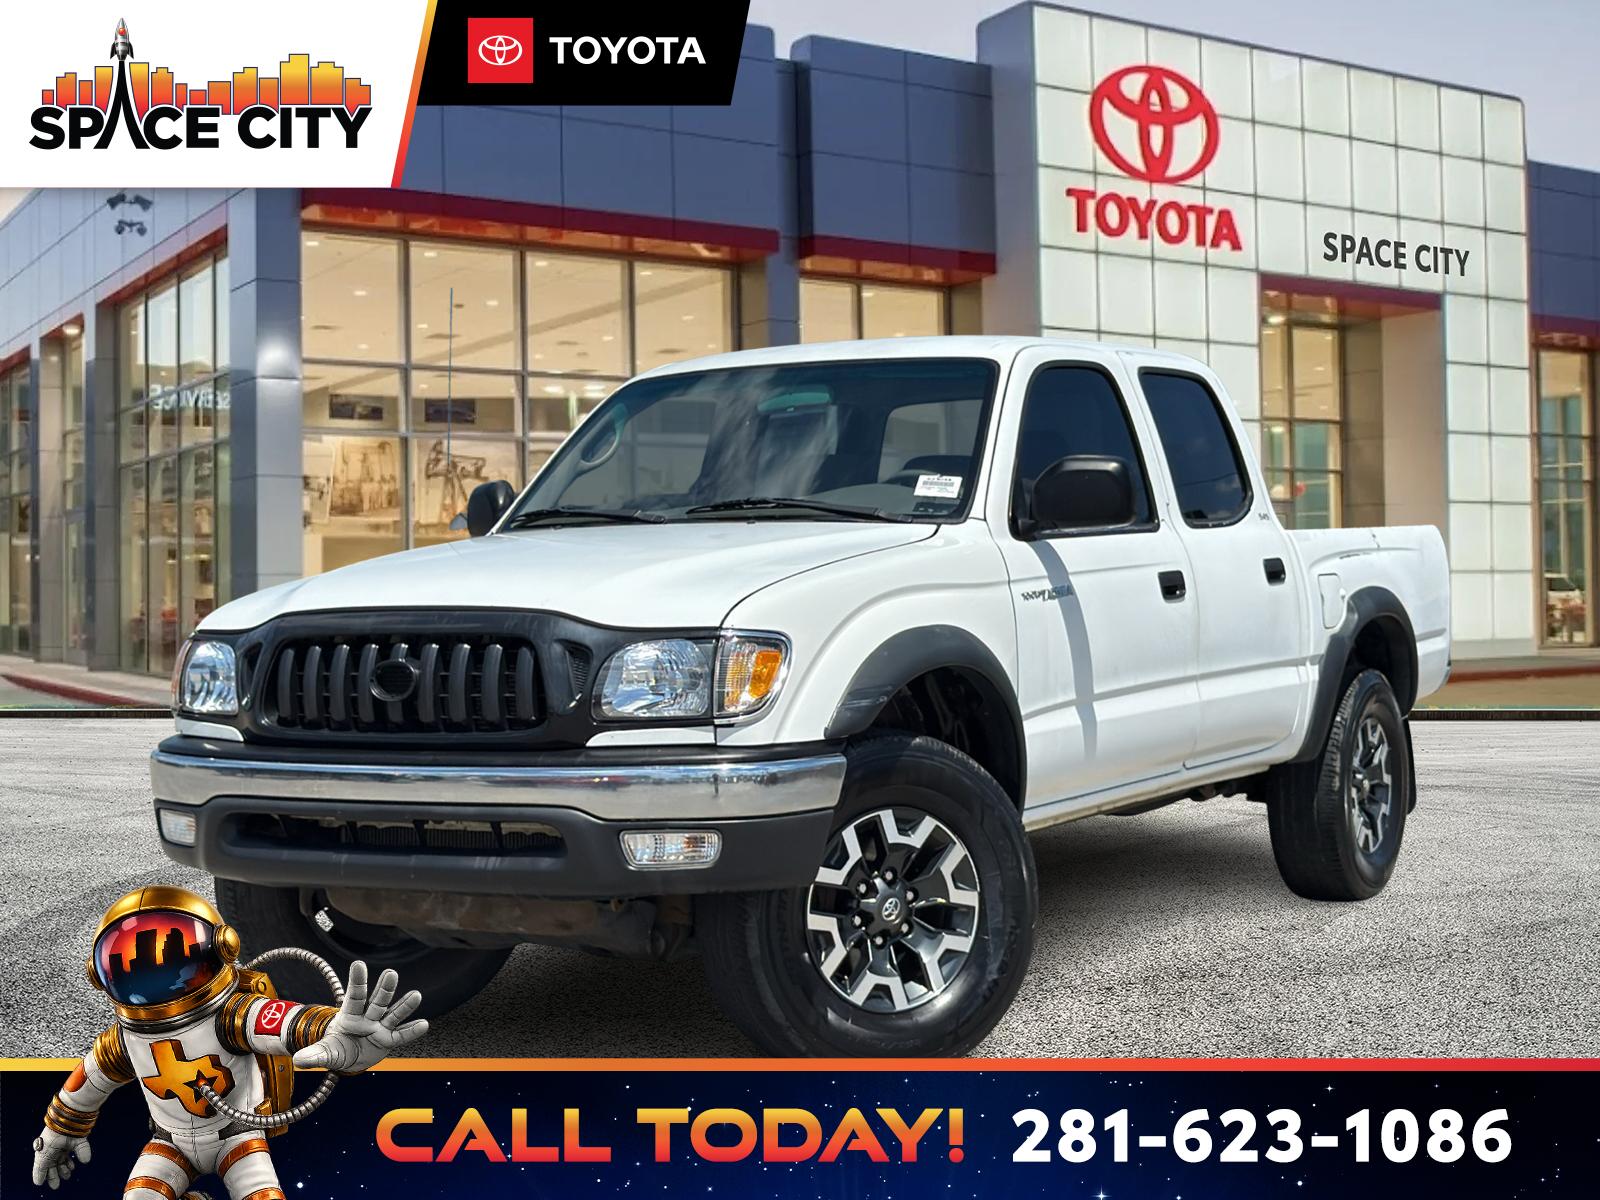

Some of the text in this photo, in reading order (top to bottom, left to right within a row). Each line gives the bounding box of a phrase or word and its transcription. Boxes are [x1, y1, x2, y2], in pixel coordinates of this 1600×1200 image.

[1066, 187, 1242, 251] TOYOTA
[1322, 231, 1471, 277] SPACE CITY
